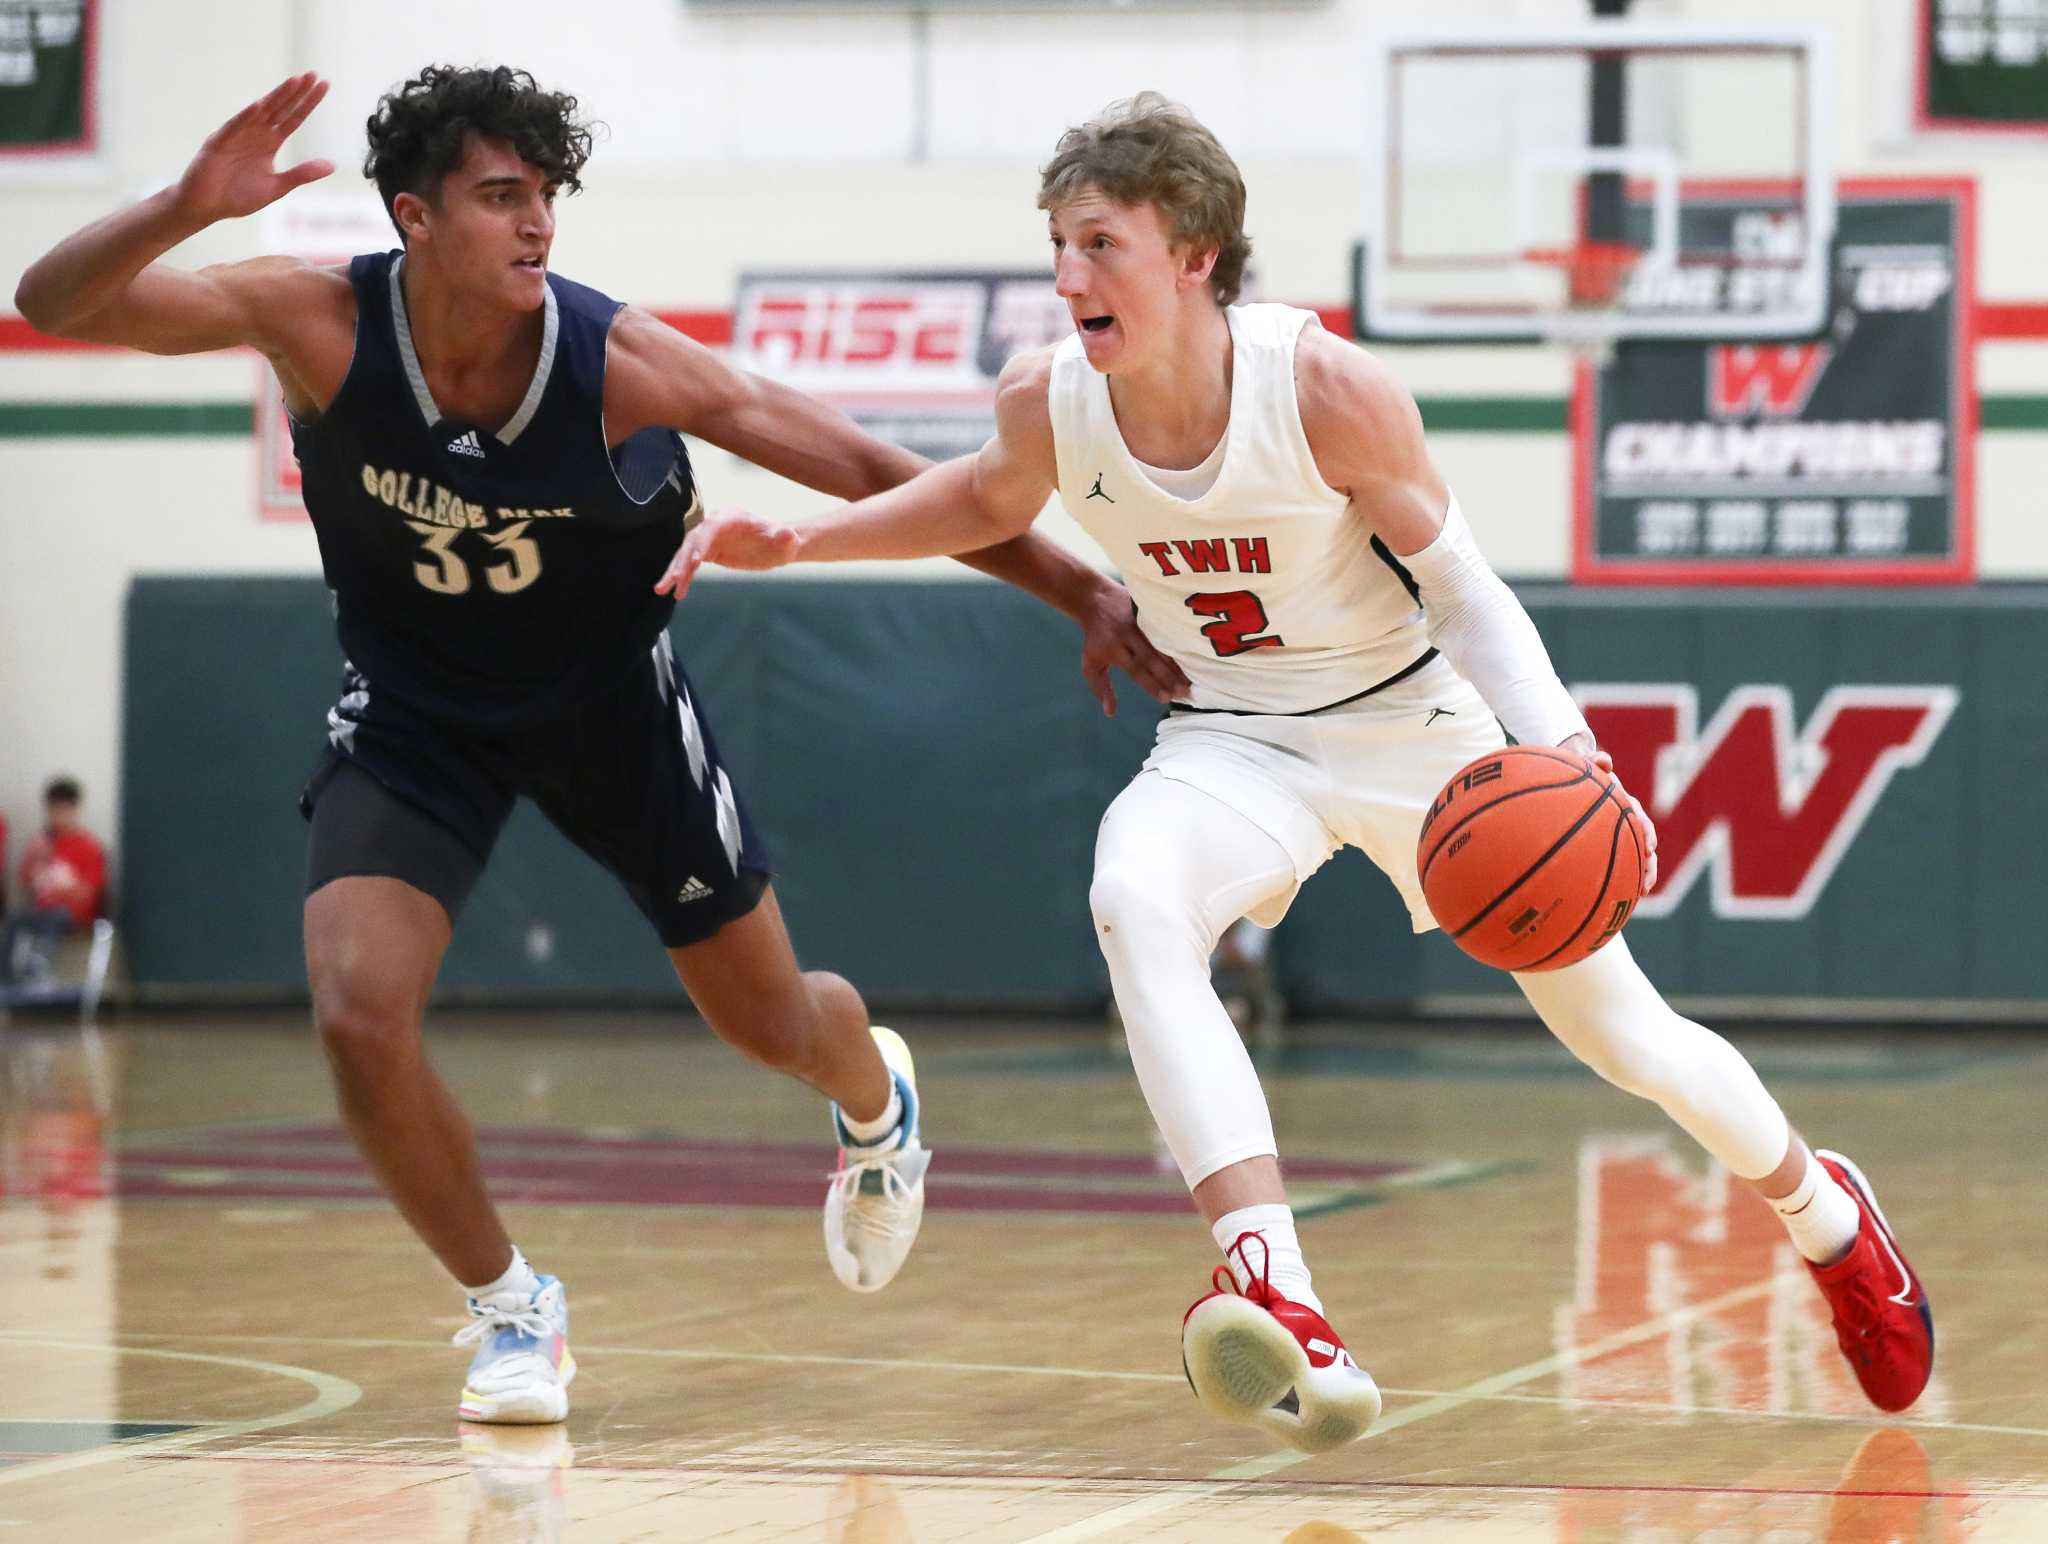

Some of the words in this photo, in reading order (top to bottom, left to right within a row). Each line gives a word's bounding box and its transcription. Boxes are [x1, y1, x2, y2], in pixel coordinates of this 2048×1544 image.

[1706, 342, 1834, 417] W
[447, 442, 486, 459] adidas
[1602, 420, 1947, 479] CHAMPIONS
[403, 518, 543, 595] 33
[1138, 536, 1272, 577] TWH
[1184, 589, 1285, 657] 2
[1569, 682, 1960, 920] W
